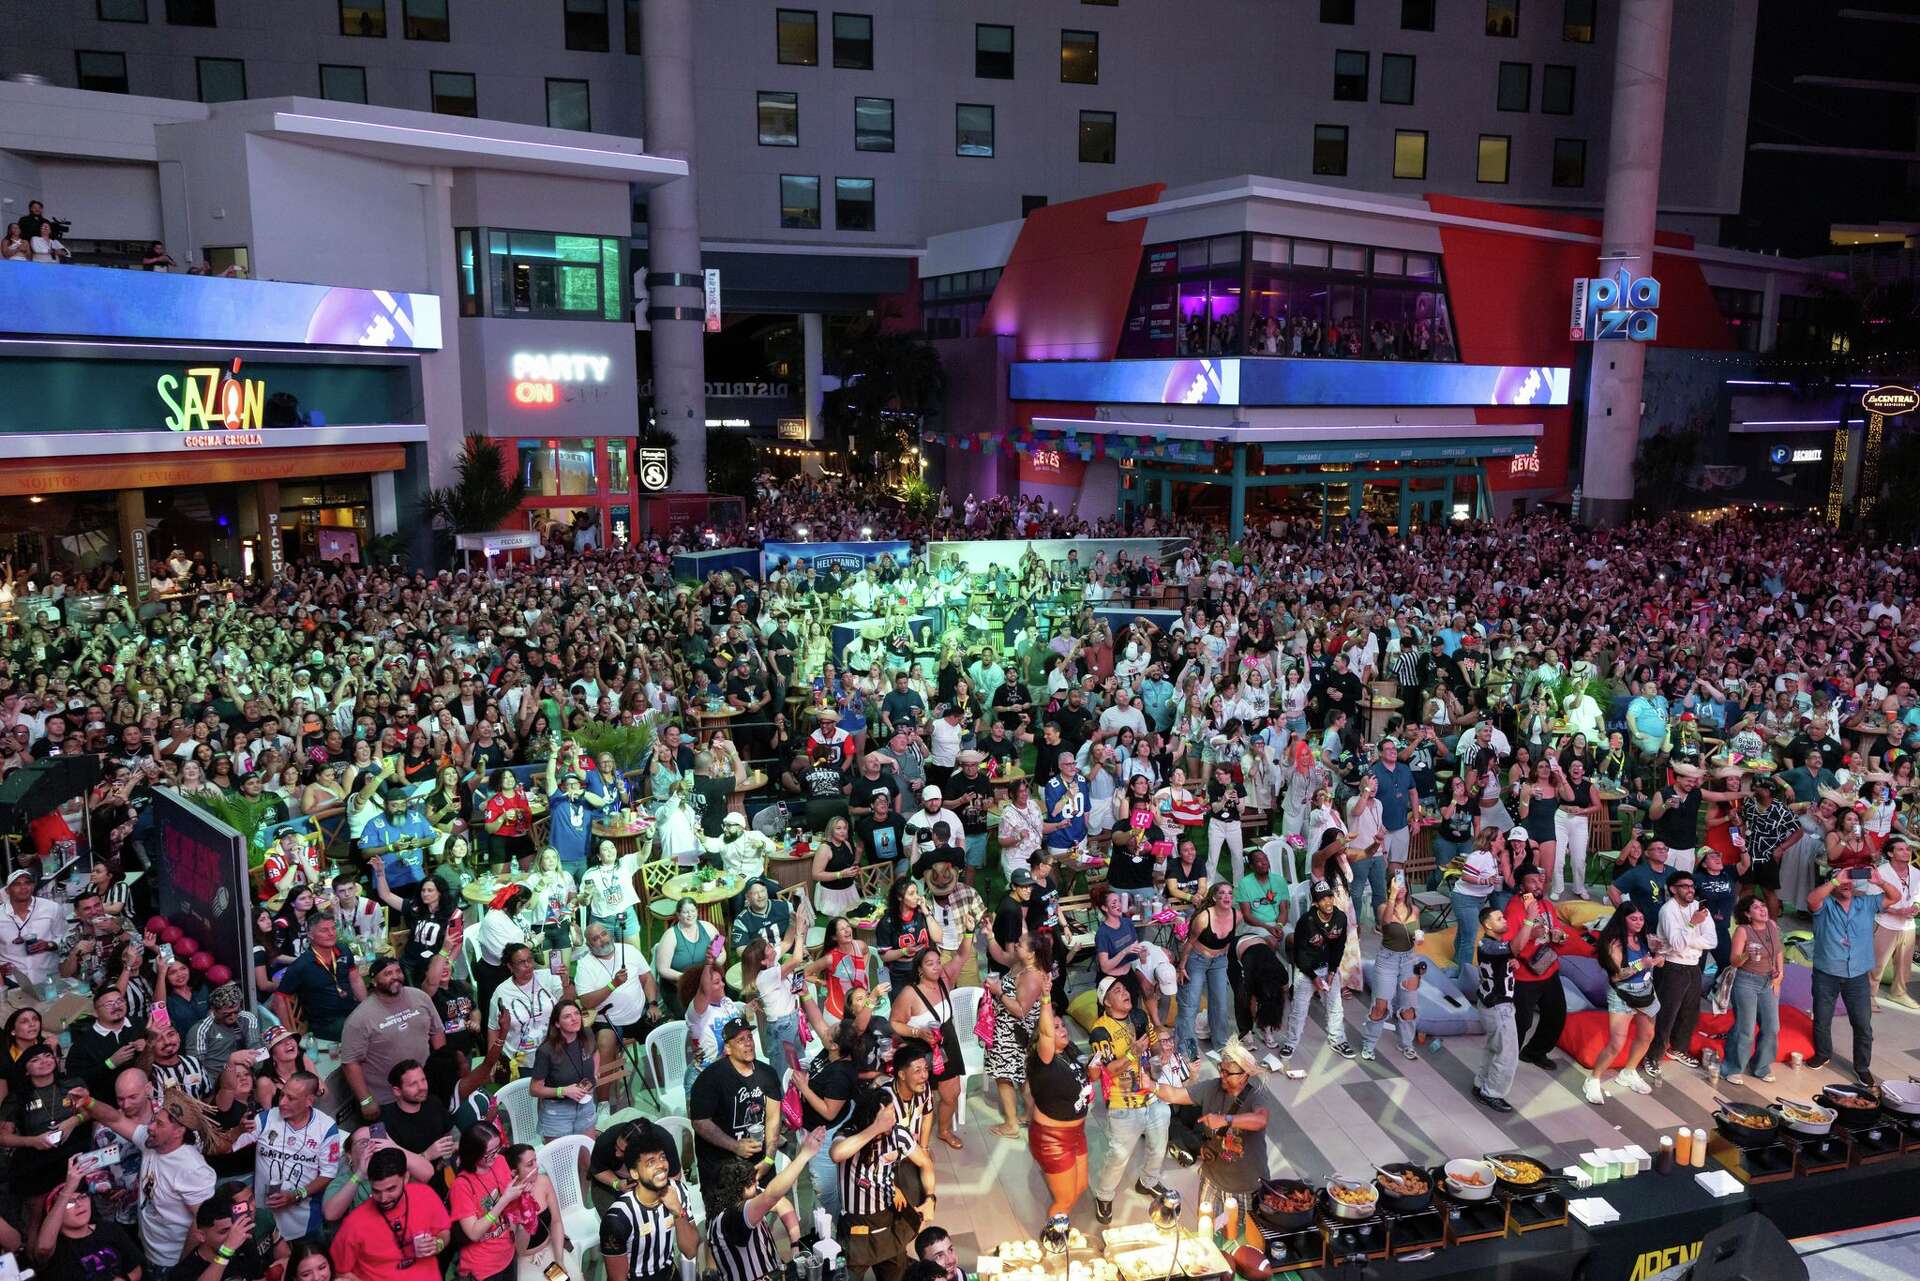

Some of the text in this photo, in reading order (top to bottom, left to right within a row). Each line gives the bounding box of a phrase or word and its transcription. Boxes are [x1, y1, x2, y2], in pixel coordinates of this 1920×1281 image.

[512, 354, 610, 382] PARTY
[157, 356, 265, 432] SAZÓN
[515, 383, 554, 403] ON
[185, 434, 263, 448] COCINA CRIOLLA
[1511, 458, 1540, 474] REYES
[134, 532, 147, 582] DRINKS
